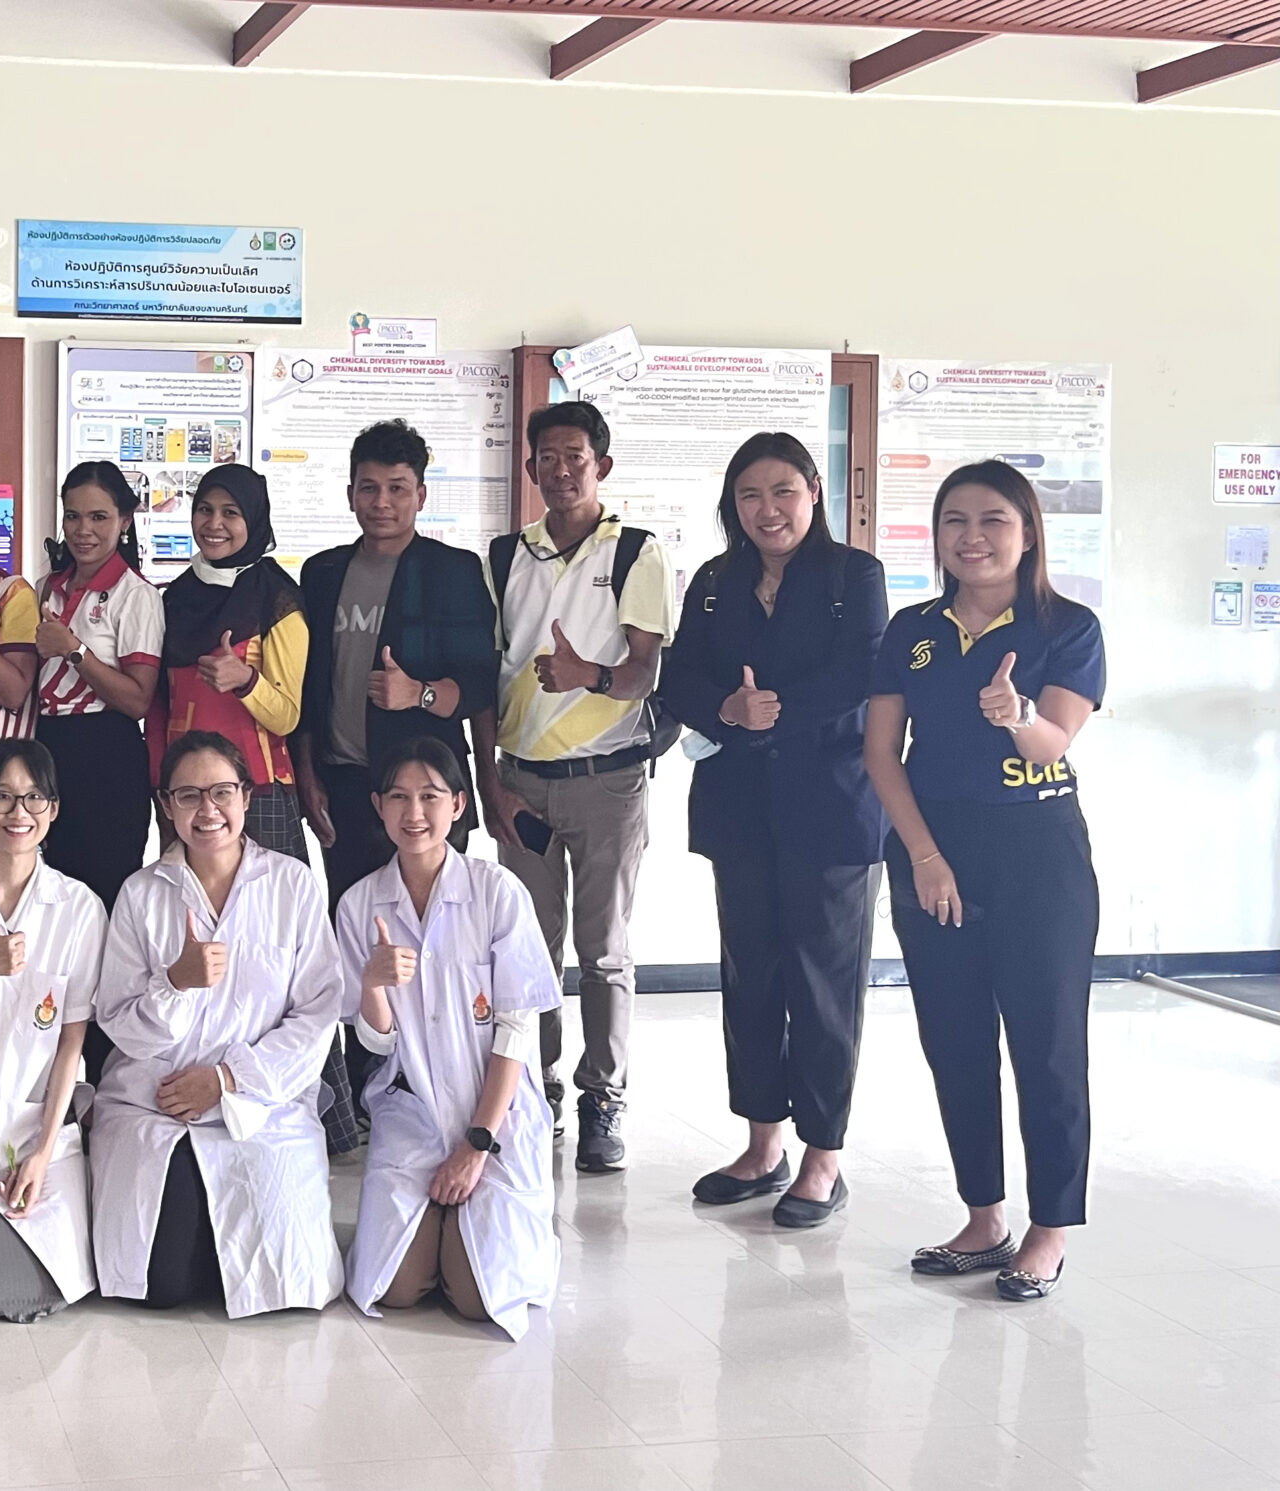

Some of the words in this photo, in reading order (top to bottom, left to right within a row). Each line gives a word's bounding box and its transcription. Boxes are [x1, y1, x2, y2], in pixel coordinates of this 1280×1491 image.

[462, 366, 500, 377] PACCON
[778, 365, 814, 375] PACCON
[942, 368, 977, 376] CHEMICAL
[981, 377, 1029, 385] DEVELOPMENT
[1061, 376, 1096, 386] PACCON
[626, 386, 653, 394] injection
[1240, 453, 1261, 464] FOR
[1224, 485, 1245, 496] USE
[1248, 485, 1276, 496] ONLY
